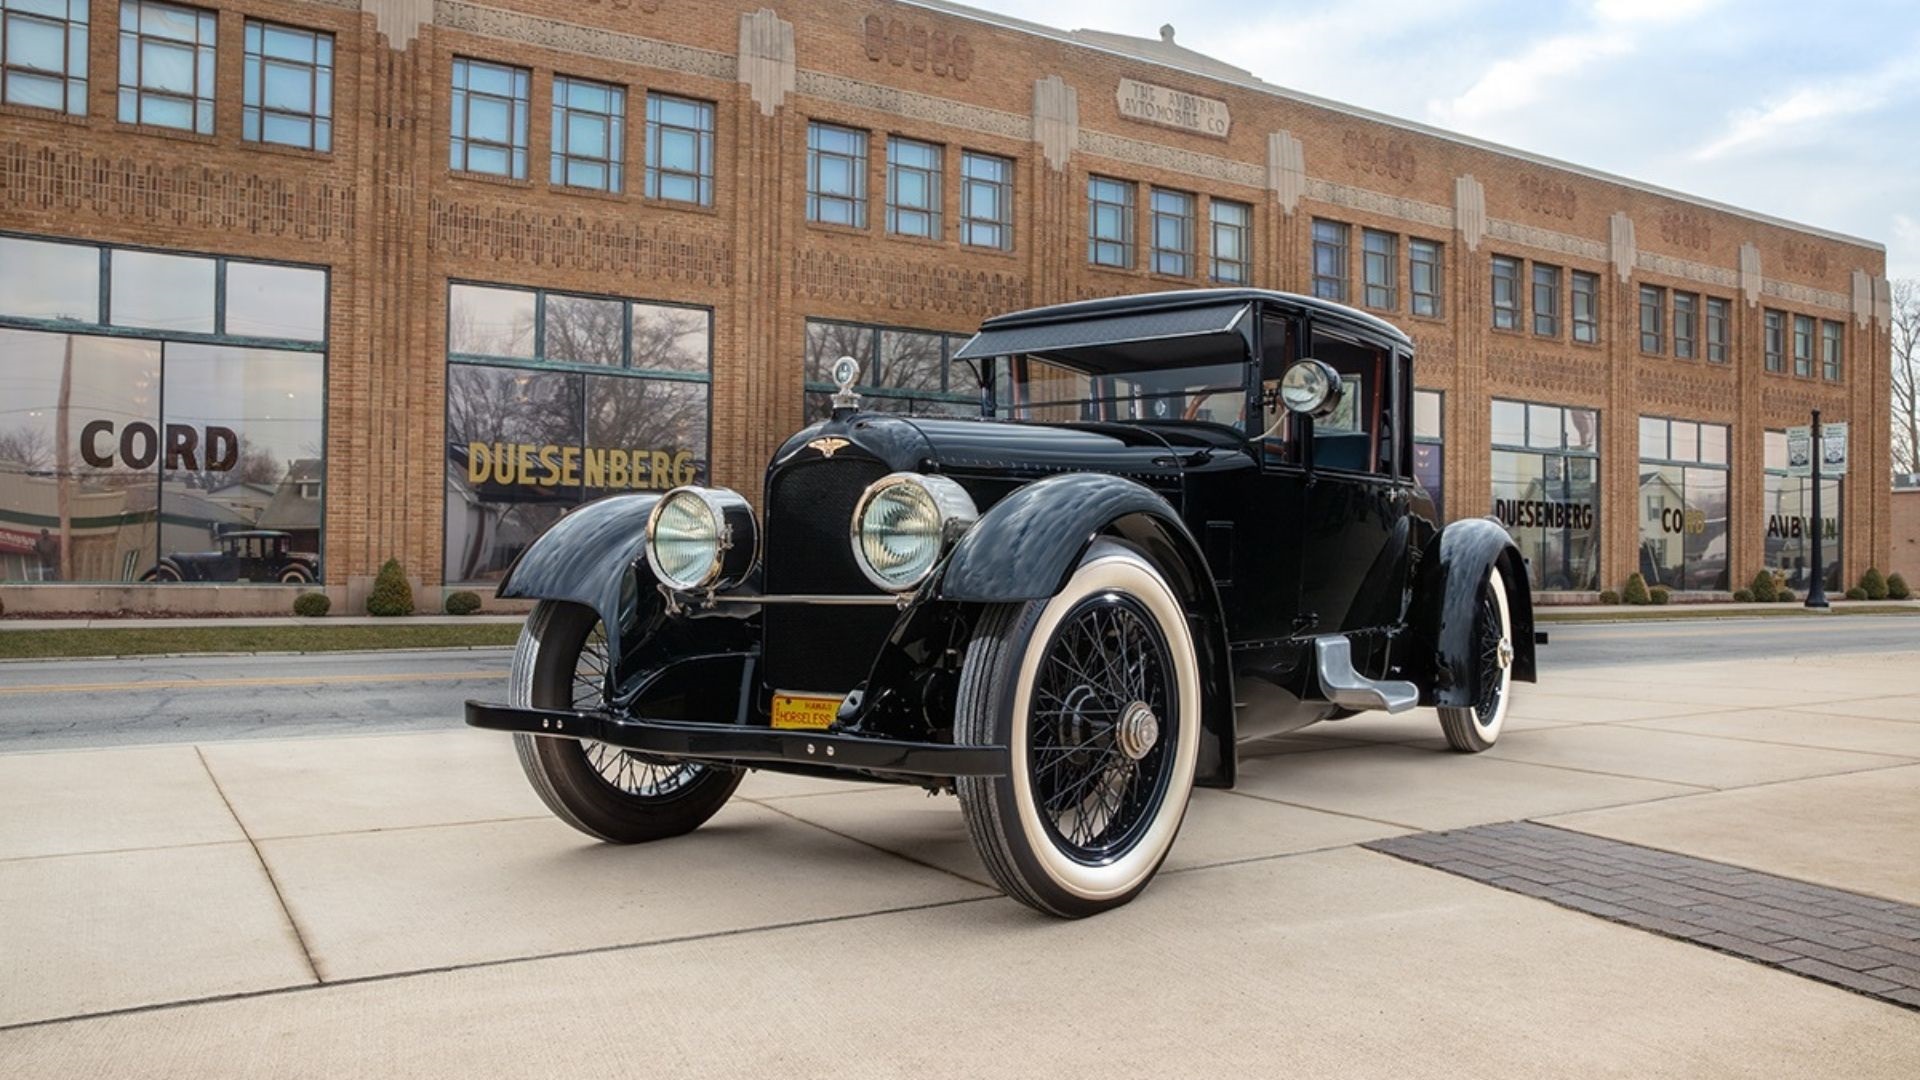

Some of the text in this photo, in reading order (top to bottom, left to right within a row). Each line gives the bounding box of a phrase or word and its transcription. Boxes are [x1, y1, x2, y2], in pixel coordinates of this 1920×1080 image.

[1131, 82, 1156, 100] THE
[1207, 117, 1225, 133] CO
[79, 419, 239, 472] CORD
[467, 441, 697, 489] DUESENBERG
[1495, 498, 1593, 530] DUESENBERG
[1661, 507, 1706, 536] CORD
[780, 710, 832, 726] HORSELESS
